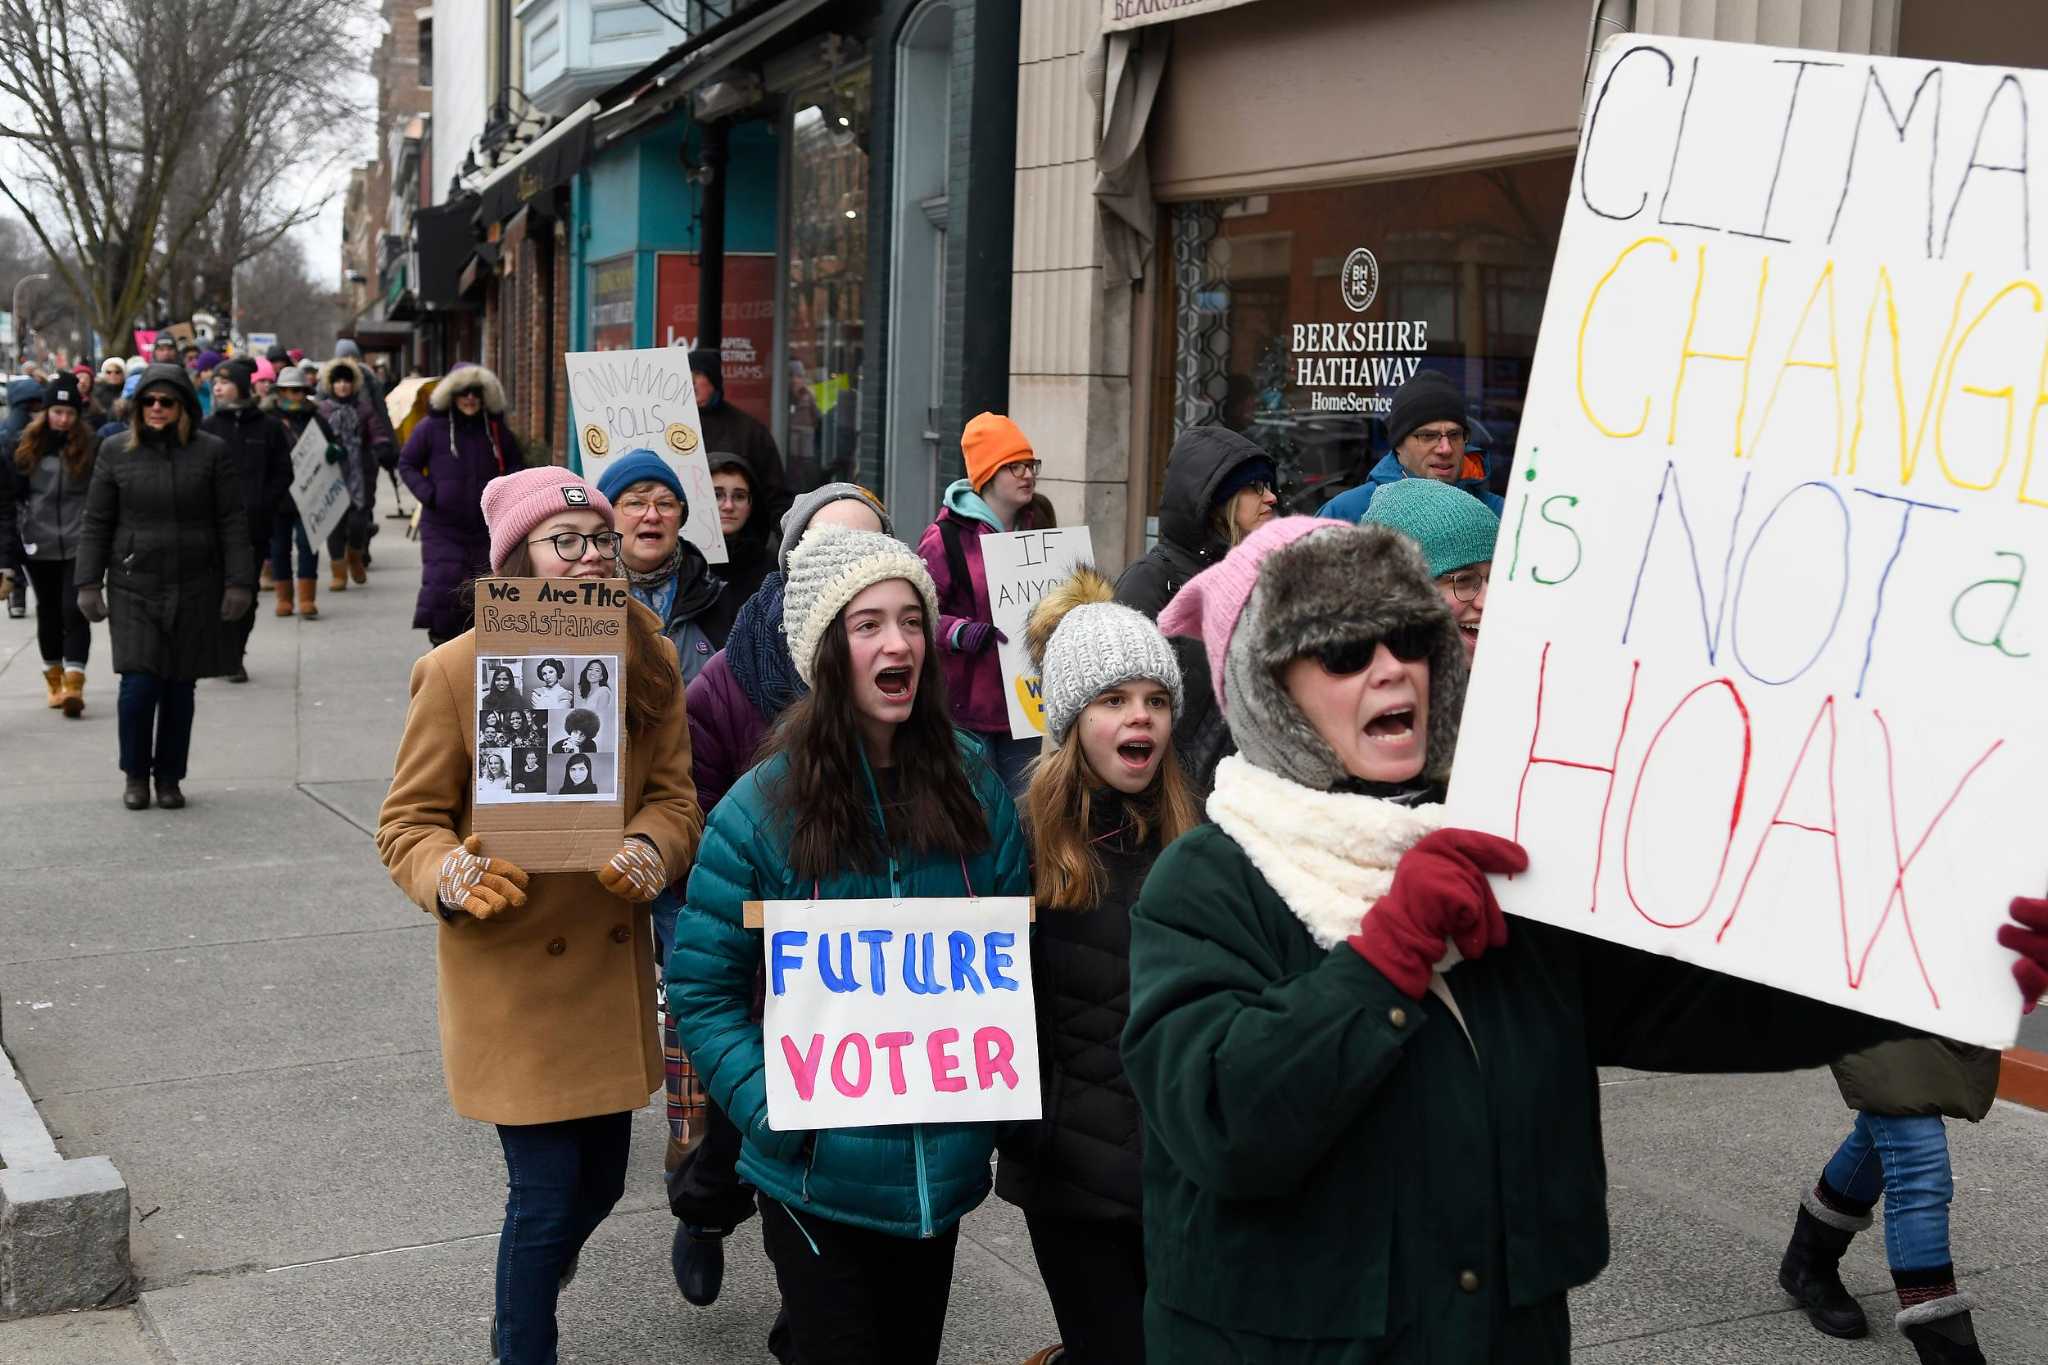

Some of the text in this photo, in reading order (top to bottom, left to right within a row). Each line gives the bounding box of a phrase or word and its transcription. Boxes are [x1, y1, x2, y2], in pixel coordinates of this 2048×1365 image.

[1581, 45, 2030, 271] CLIMA
[1351, 280, 1368, 296] HS
[1352, 264, 1368, 281] BH
[720, 336, 753, 349] APITAL
[1291, 320, 1428, 353] BERKSHIRE
[721, 350, 757, 363] ISTRICT
[721, 364, 763, 380] LLIAMS
[1296, 356, 1422, 387] HATHAWAY
[573, 357, 692, 413] CINNAMON
[1311, 391, 1393, 413] HomeService
[606, 404, 666, 440] ROLLS
[1014, 530, 1064, 567] IF
[1508, 446, 2032, 700] is NOT a
[488, 581, 627, 608] We Are The
[998, 577, 1060, 609] ANY
[482, 605, 620, 638] Resistance
[1508, 640, 2005, 1010] HOAX
[771, 928, 1020, 998] FUTURE
[780, 1025, 1019, 1102] VOTER
